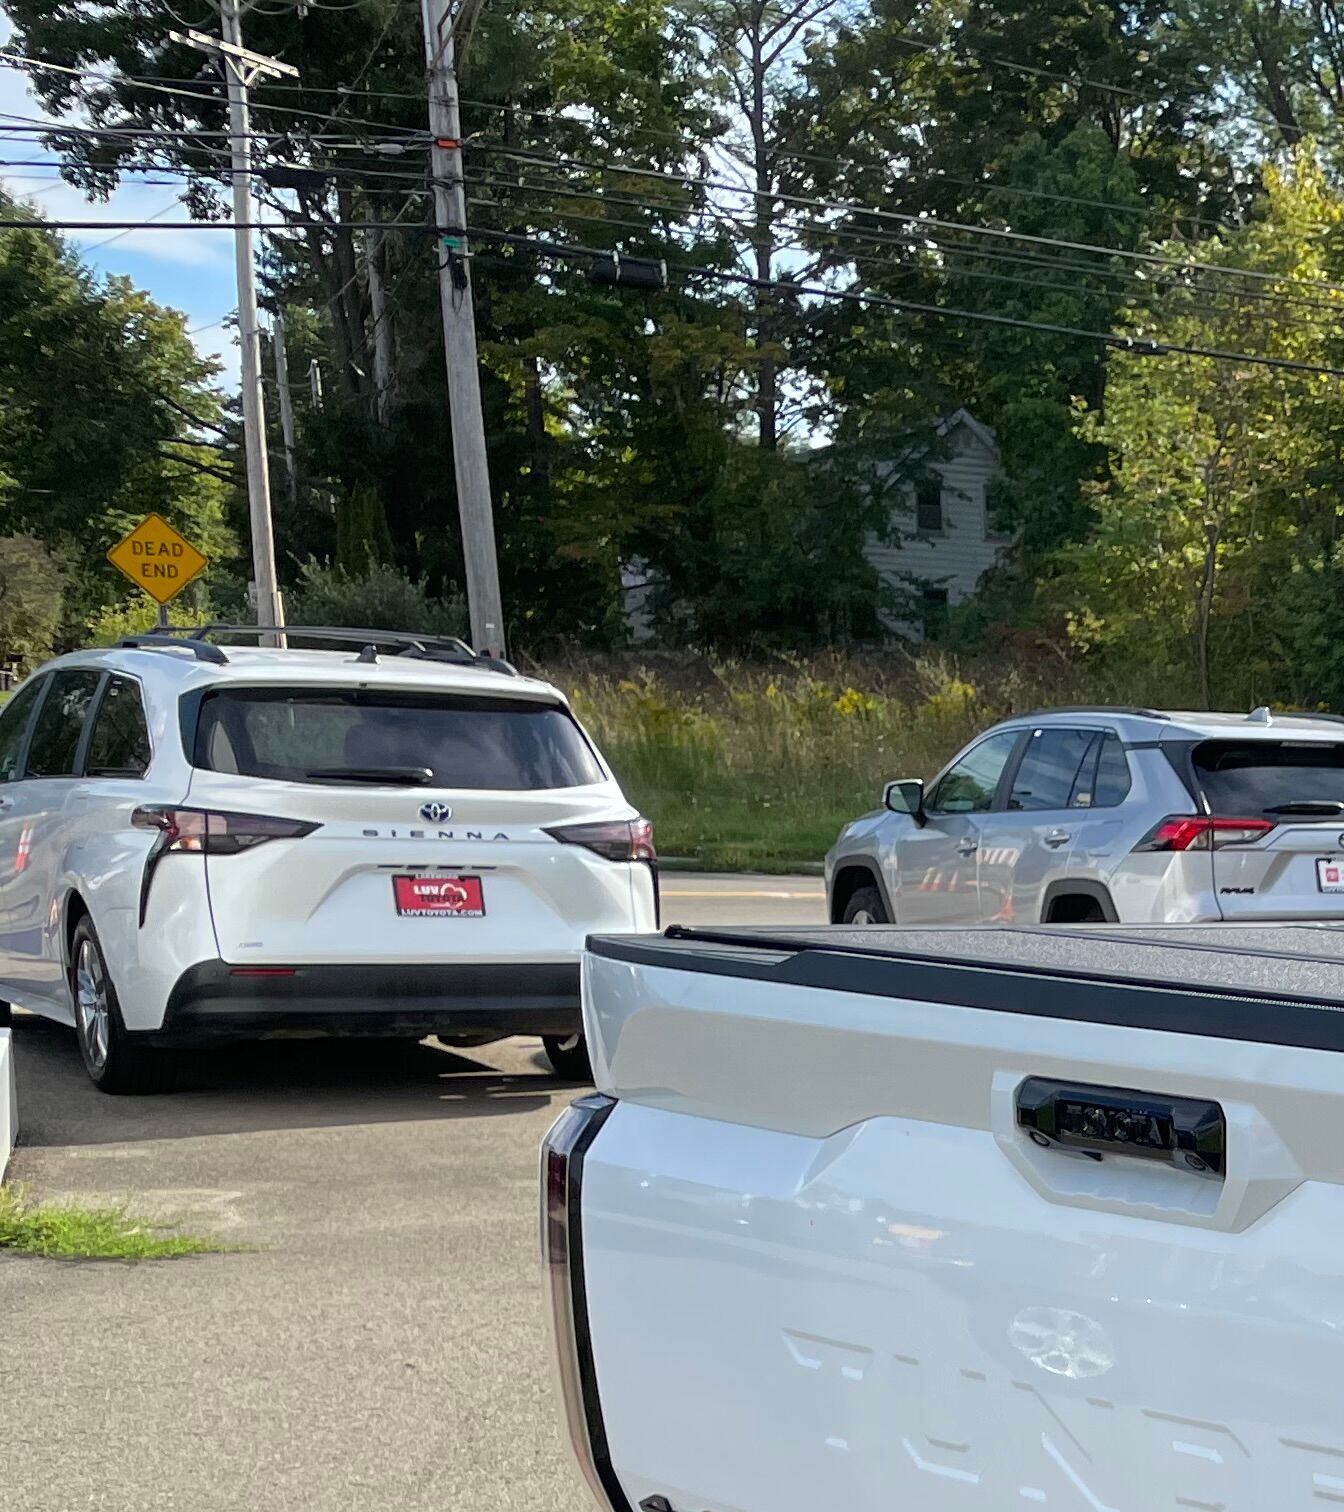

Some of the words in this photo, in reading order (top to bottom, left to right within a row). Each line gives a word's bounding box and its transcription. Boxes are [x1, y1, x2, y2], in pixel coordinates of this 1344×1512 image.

[132, 541, 183, 557] DEAD
[141, 563, 179, 578] END
[362, 829, 510, 841] SIENNA
[413, 884, 440, 895] LUV
